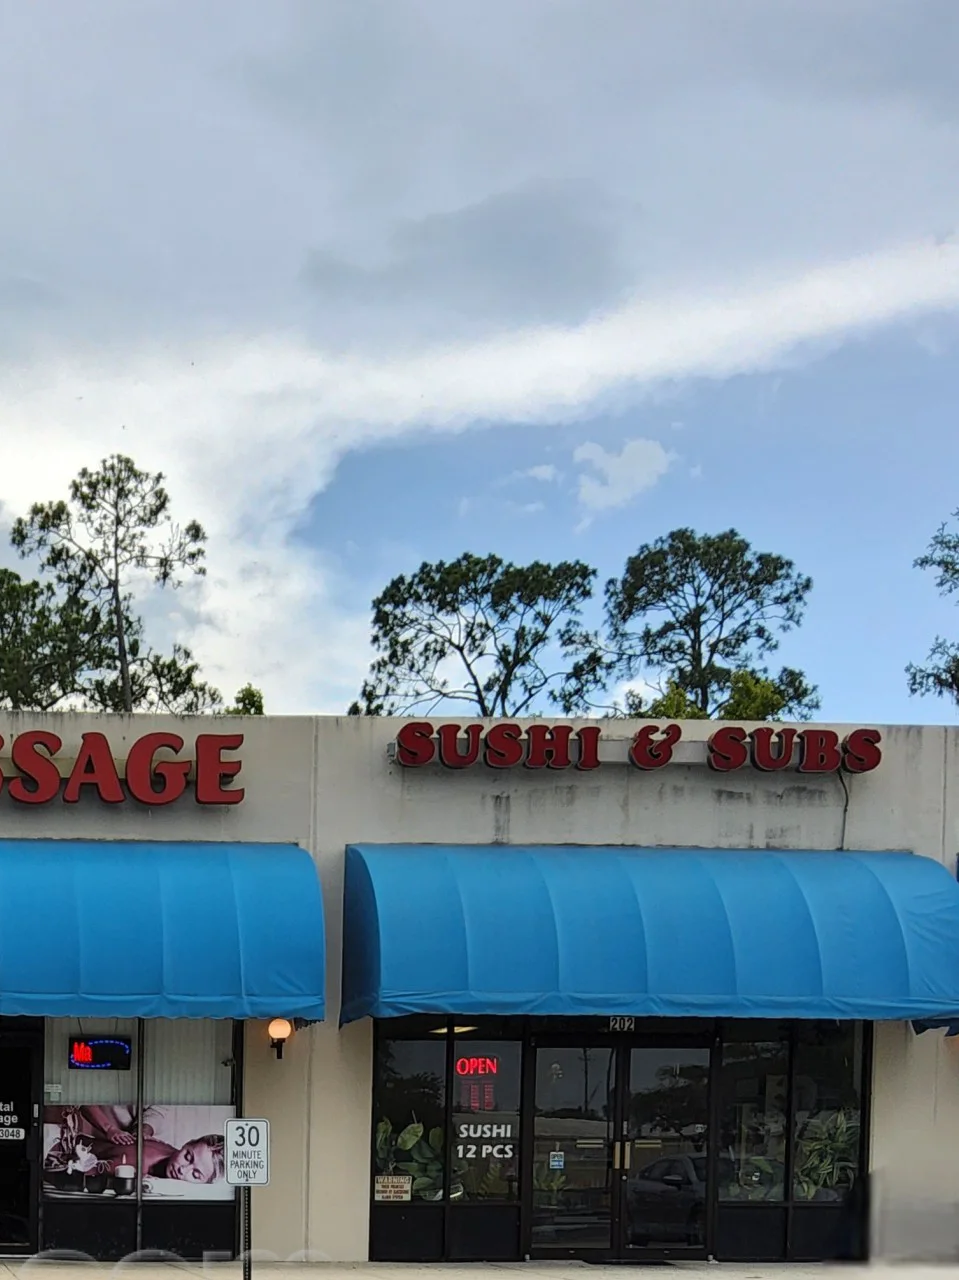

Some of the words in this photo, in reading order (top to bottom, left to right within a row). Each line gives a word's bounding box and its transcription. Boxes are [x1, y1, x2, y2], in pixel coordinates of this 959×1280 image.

[397, 722, 602, 771] SUSHI
[630, 723, 682, 770] &
[707, 726, 882, 773] SUBS
[611, 1017, 635, 1031] 202
[456, 1058, 497, 1075] OPEN
[234, 1126, 260, 1147] 30
[459, 1124, 512, 1138] SUSHI
[232, 1150, 262, 1160] MINUTE
[456, 1144, 477, 1158] 12
[481, 1144, 514, 1159] PCS
[230, 1160, 265, 1170] PARKING
[237, 1170, 257, 1179] ONLY
